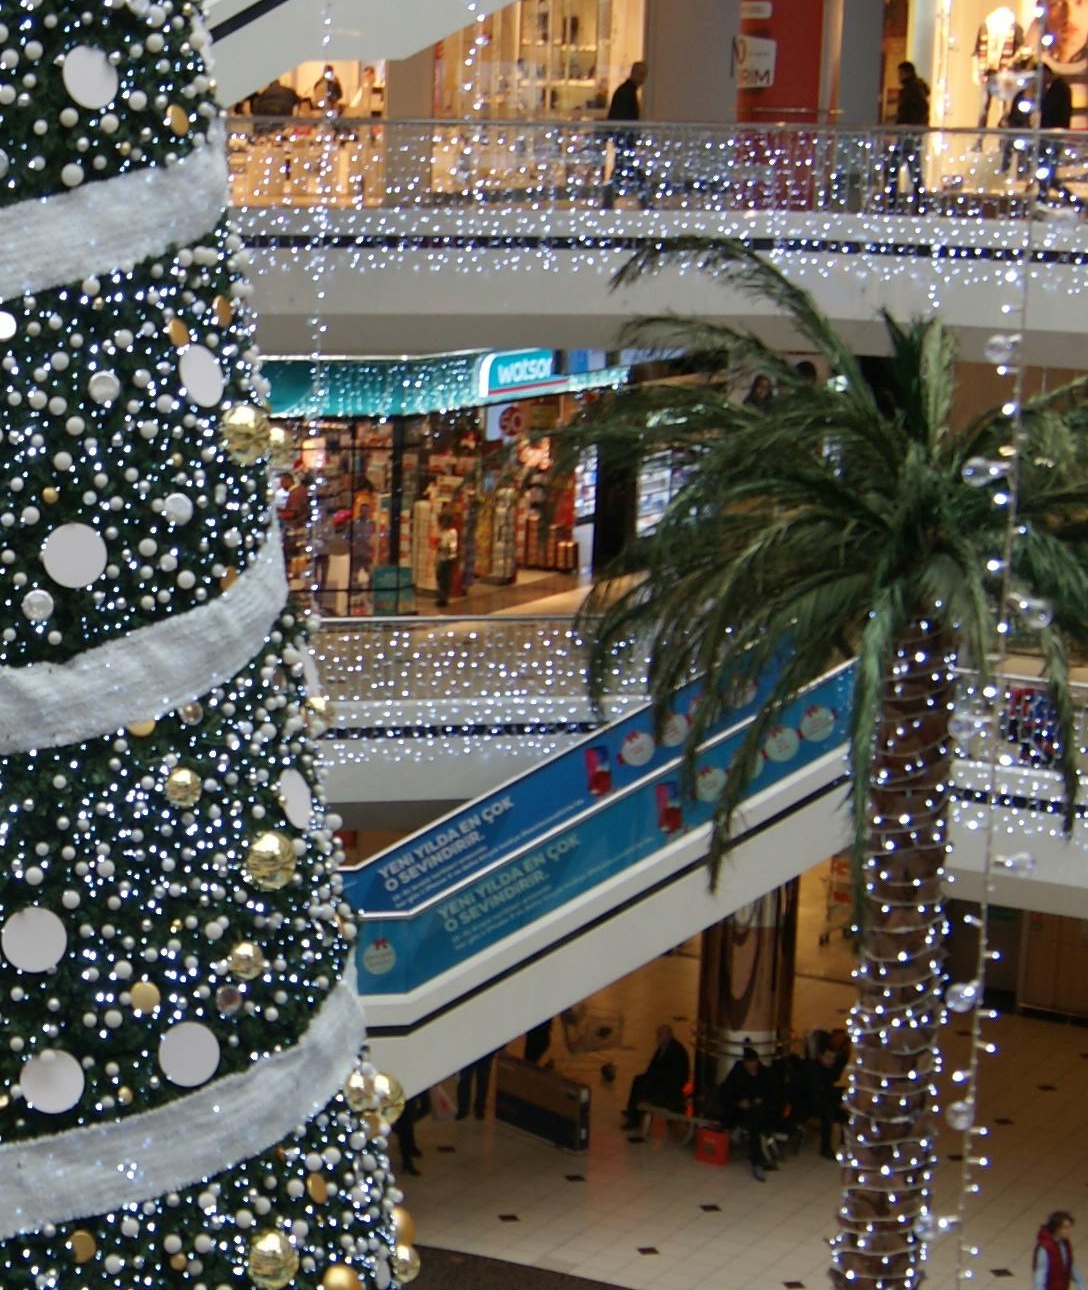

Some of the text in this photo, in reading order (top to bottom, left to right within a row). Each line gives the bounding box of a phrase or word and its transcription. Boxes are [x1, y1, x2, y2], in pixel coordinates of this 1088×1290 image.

[413, 828, 459, 859] YILDA
[459, 816, 481, 833] EN
[481, 797, 515, 824] ÇOK
[523, 854, 545, 872] EN
[384, 877, 399, 892] O
